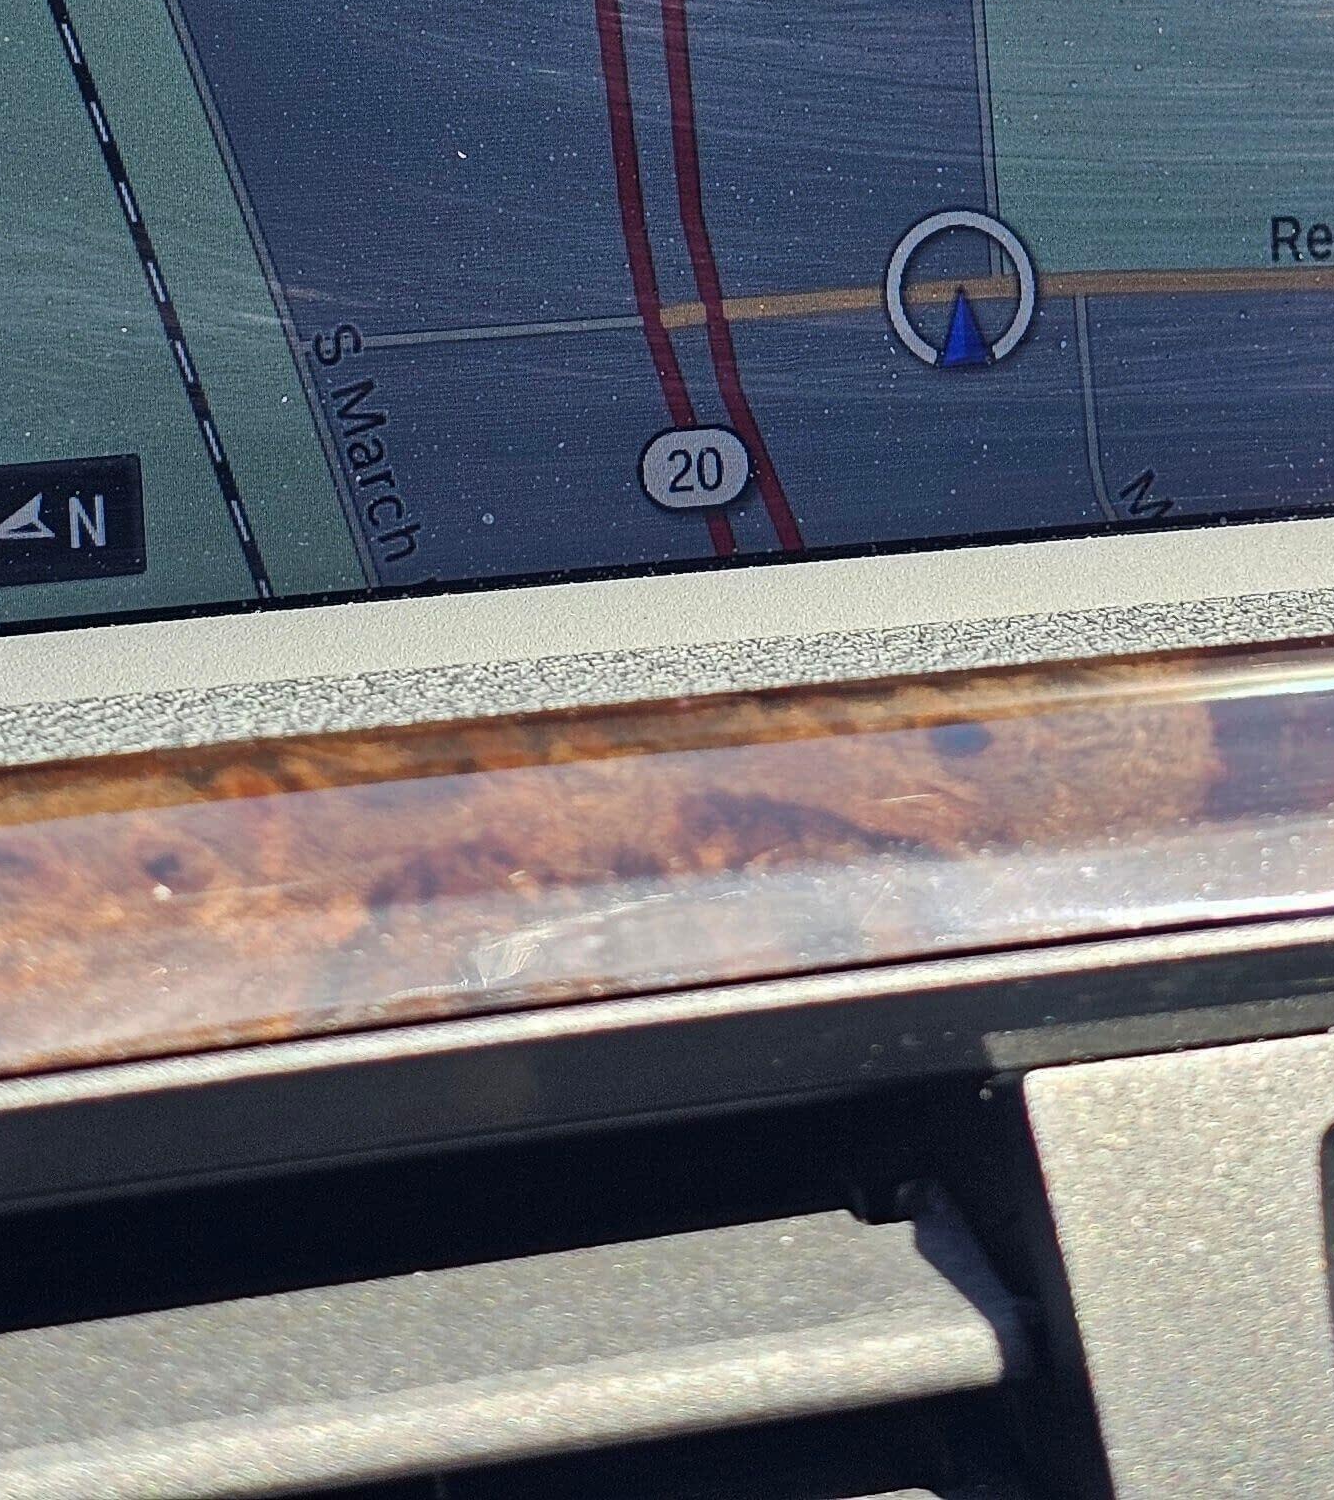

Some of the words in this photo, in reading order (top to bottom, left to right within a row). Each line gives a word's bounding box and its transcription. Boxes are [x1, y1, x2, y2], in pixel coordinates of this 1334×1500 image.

[313, 323, 363, 367] S
[330, 377, 422, 562] March
[667, 445, 724, 495] 20
[69, 494, 107, 549] N
